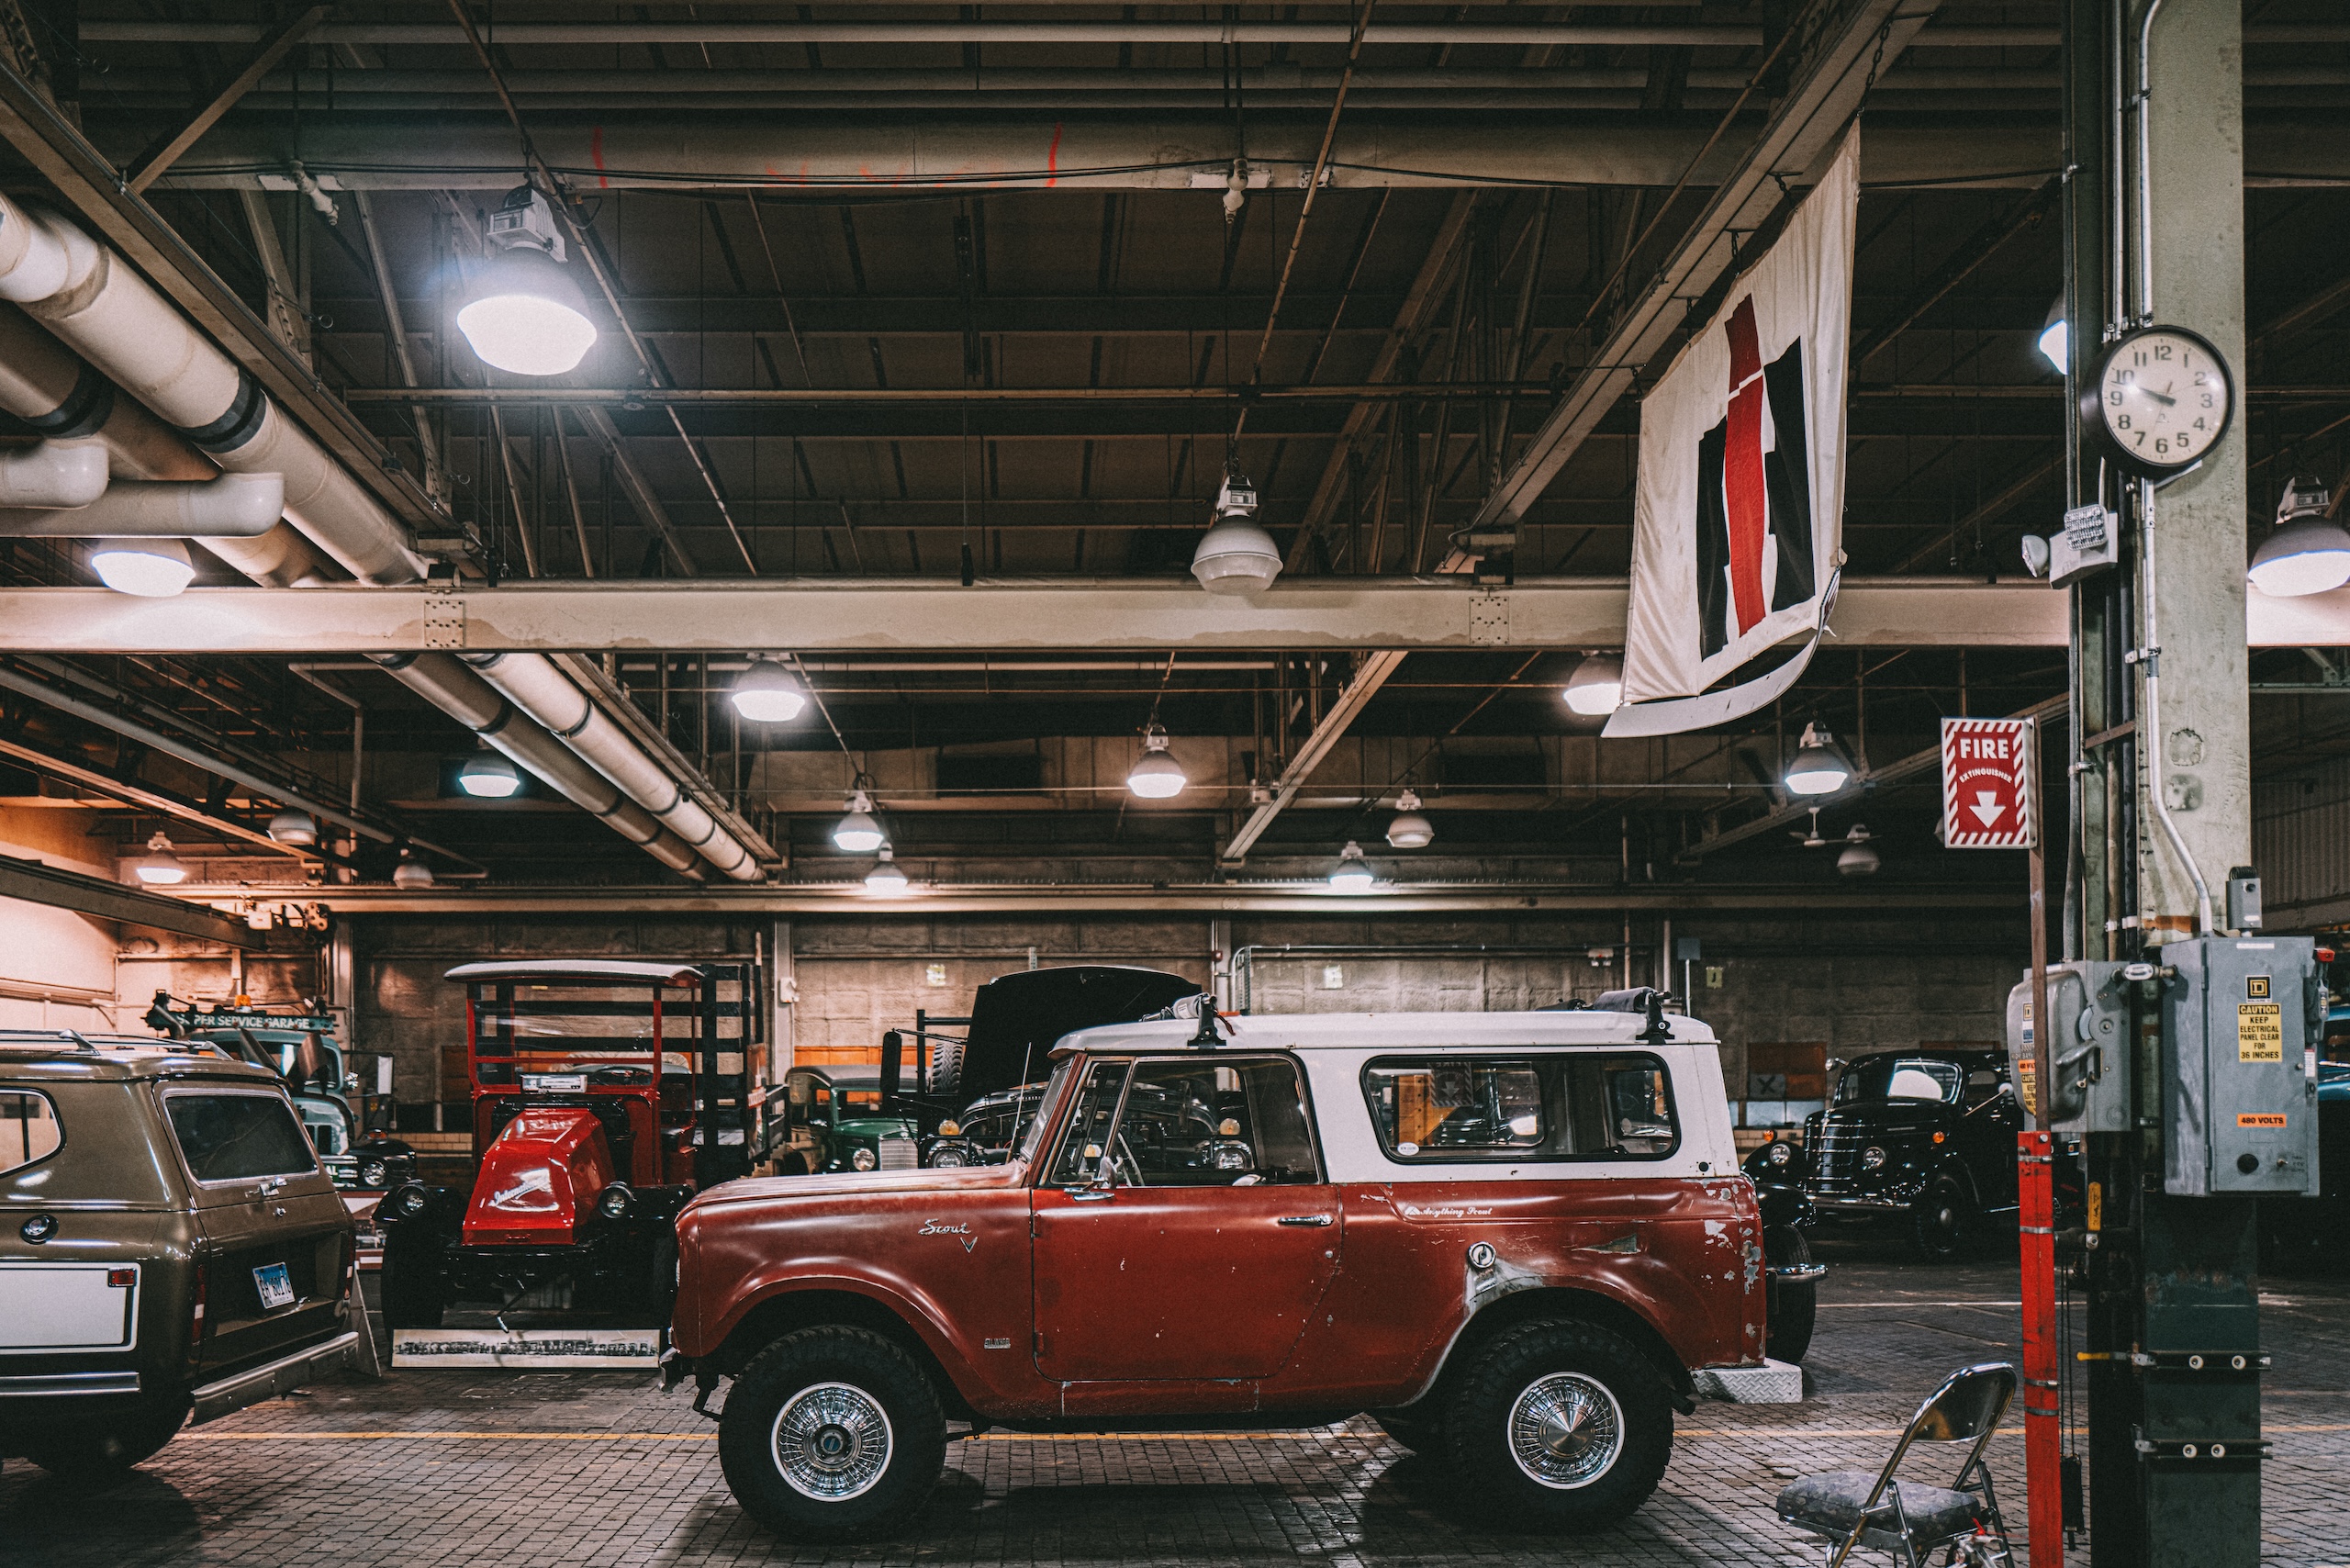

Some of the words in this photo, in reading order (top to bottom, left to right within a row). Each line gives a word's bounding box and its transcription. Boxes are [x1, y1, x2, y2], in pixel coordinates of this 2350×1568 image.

[2134, 352, 2147, 367] 11
[2154, 345, 2172, 361] 12
[2115, 369, 2135, 386] 10
[2194, 371, 2207, 386] 2
[2109, 391, 2123, 406] 9
[2200, 393, 2213, 409] 3
[2118, 414, 2132, 430] 8
[2193, 417, 2206, 431] 4
[2134, 431, 2146, 447] 7
[2155, 438, 2168, 454] 6
[2177, 432, 2189, 448] 5
[1960, 738, 2009, 759] FIRE
[1959, 767, 2012, 783] EXTINGUISHER
[2240, 1005, 2278, 1014] CAUTION
[176, 1014, 216, 1026] SPER
[218, 1014, 263, 1027] SERVICE
[264, 1016, 310, 1029] GARAGE
[2260, 1033, 2279, 1041] CLEAR
[2241, 1051, 2250, 1059] 36
[2252, 1051, 2279, 1059] INCHES
[2241, 1116, 2256, 1125] 480
[2257, 1116, 2285, 1125] VOLTS
[1421, 1207, 1464, 1218] Anything
[1467, 1207, 1493, 1215] Scout
[918, 1218, 972, 1236] Scout
